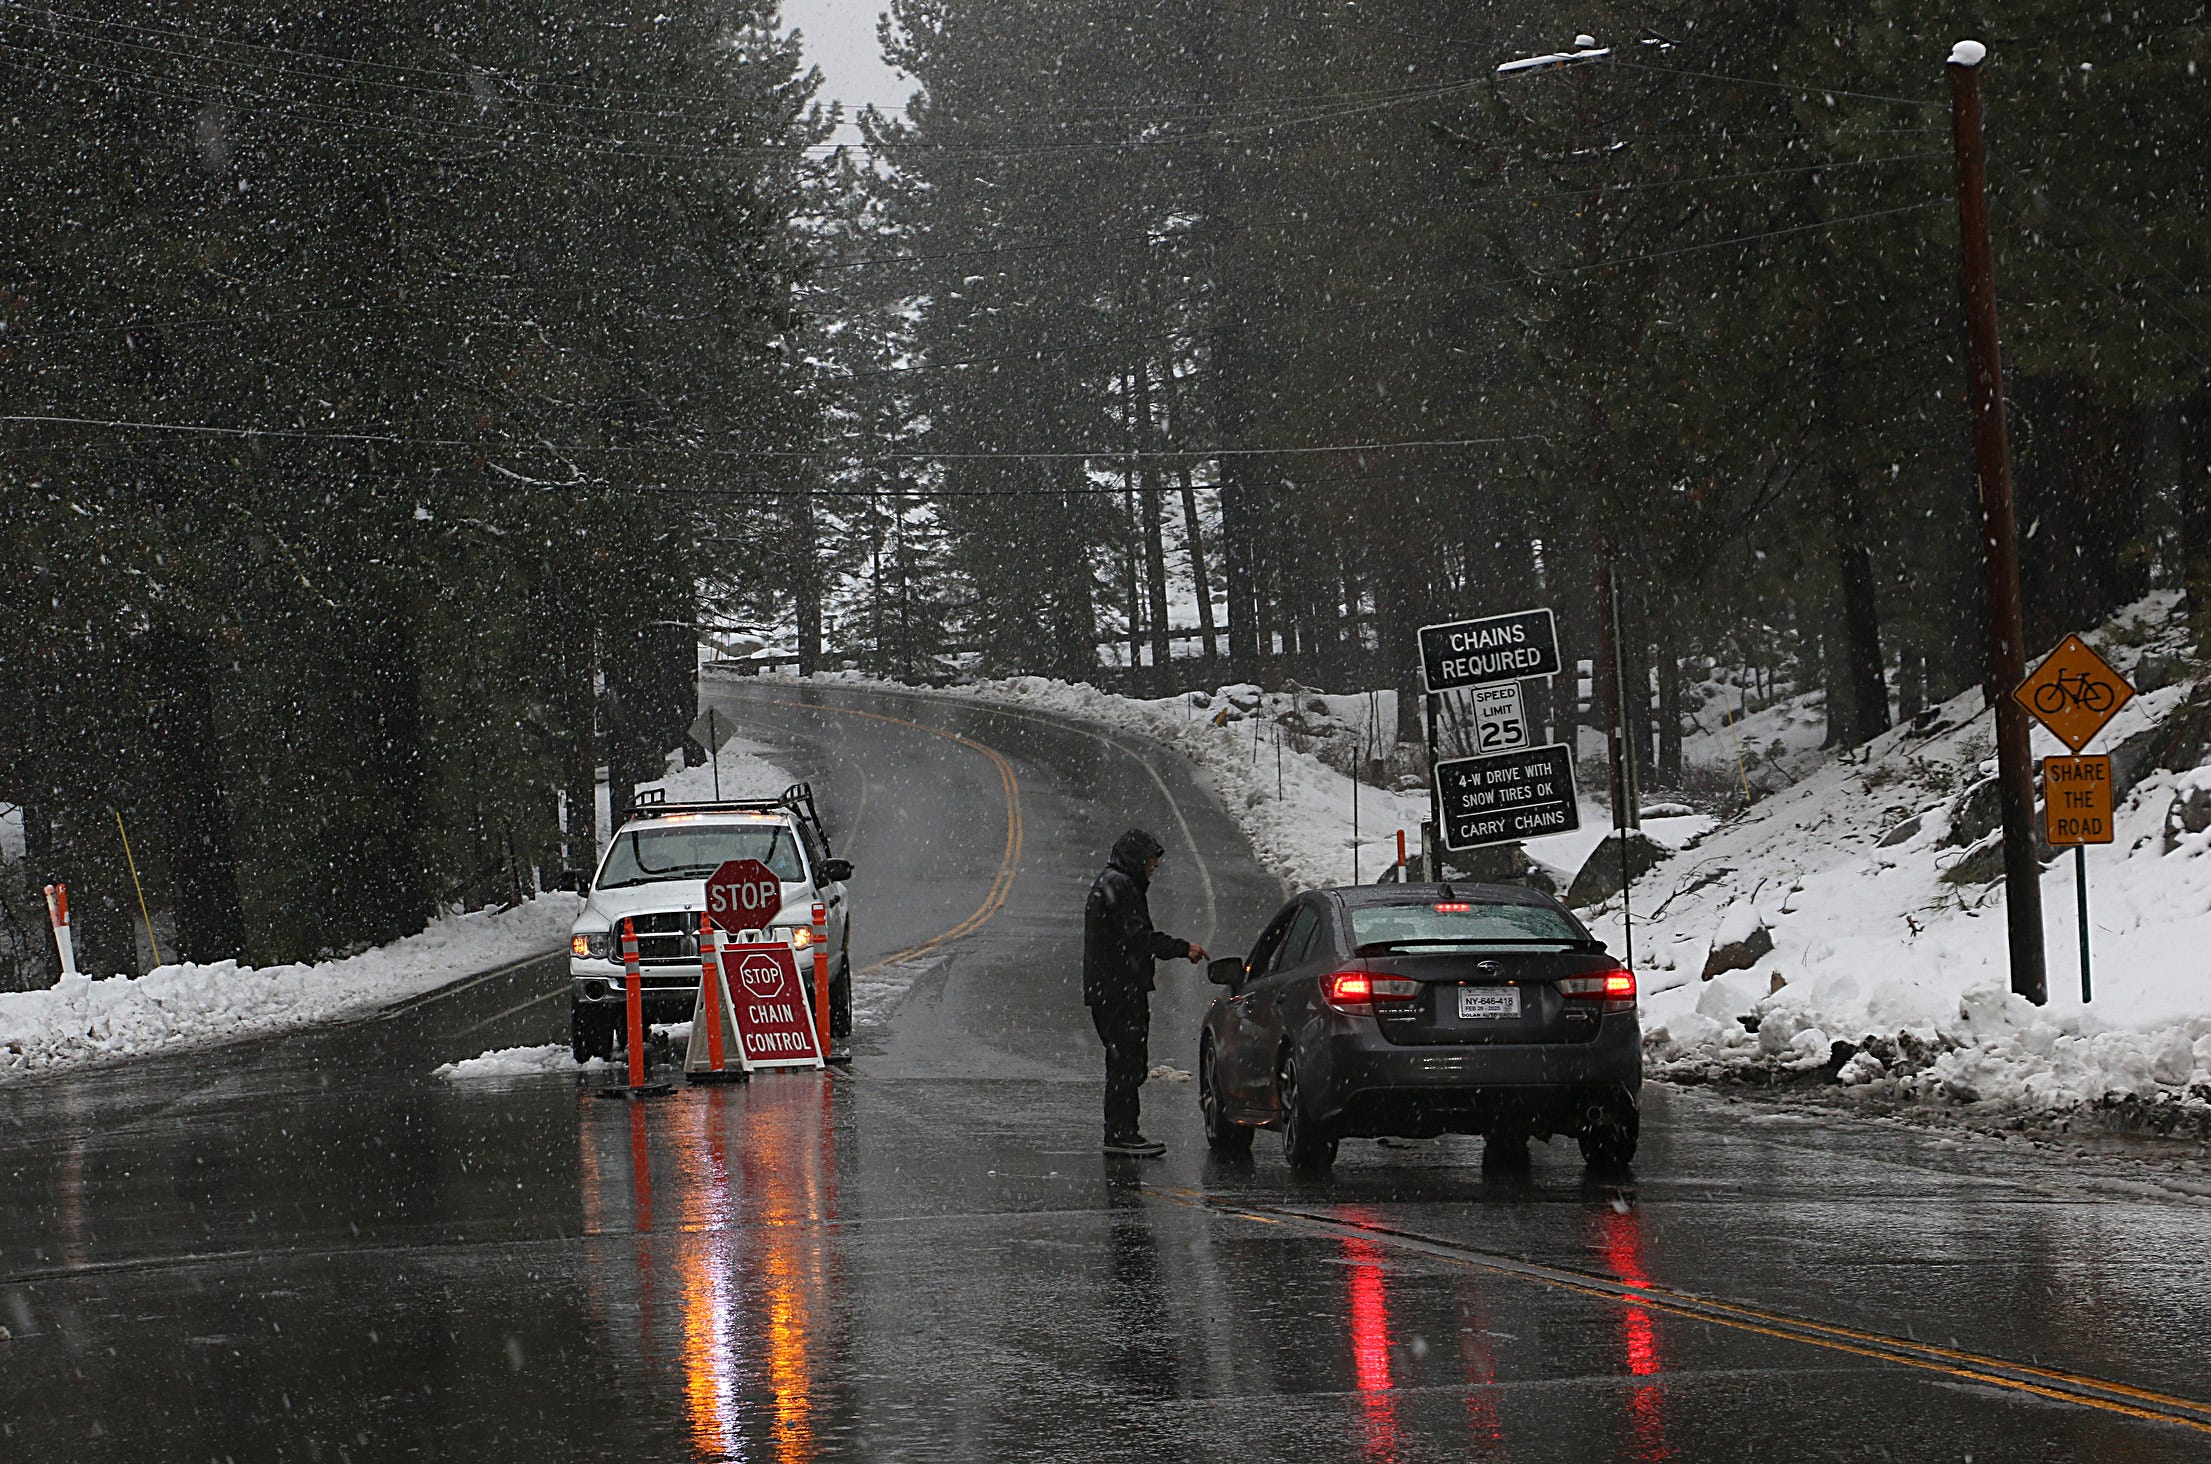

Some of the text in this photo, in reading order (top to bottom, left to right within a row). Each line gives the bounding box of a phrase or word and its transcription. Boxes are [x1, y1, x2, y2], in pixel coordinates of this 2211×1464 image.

[1451, 625, 1526, 652] CHAINS
[1441, 648, 1541, 679] REQUIRED
[1476, 688, 1516, 703] SPEED
[1483, 704, 1512, 718] LIMIT
[1481, 719, 1523, 748] 25
[1458, 763, 1552, 788] 4-W DRIVE WITH
[2050, 763, 2105, 782] SHARE
[1462, 782, 1553, 808] SNOW TIRES OK
[2064, 791, 2094, 808] THE
[1460, 810, 1565, 838] CARRY CHAINS
[2058, 818, 2103, 836] ROAD
[711, 881, 777, 913] STOP
[743, 966, 780, 985] STOP
[749, 1004, 794, 1025] CHAIN
[746, 1031, 812, 1053] CONTROL
